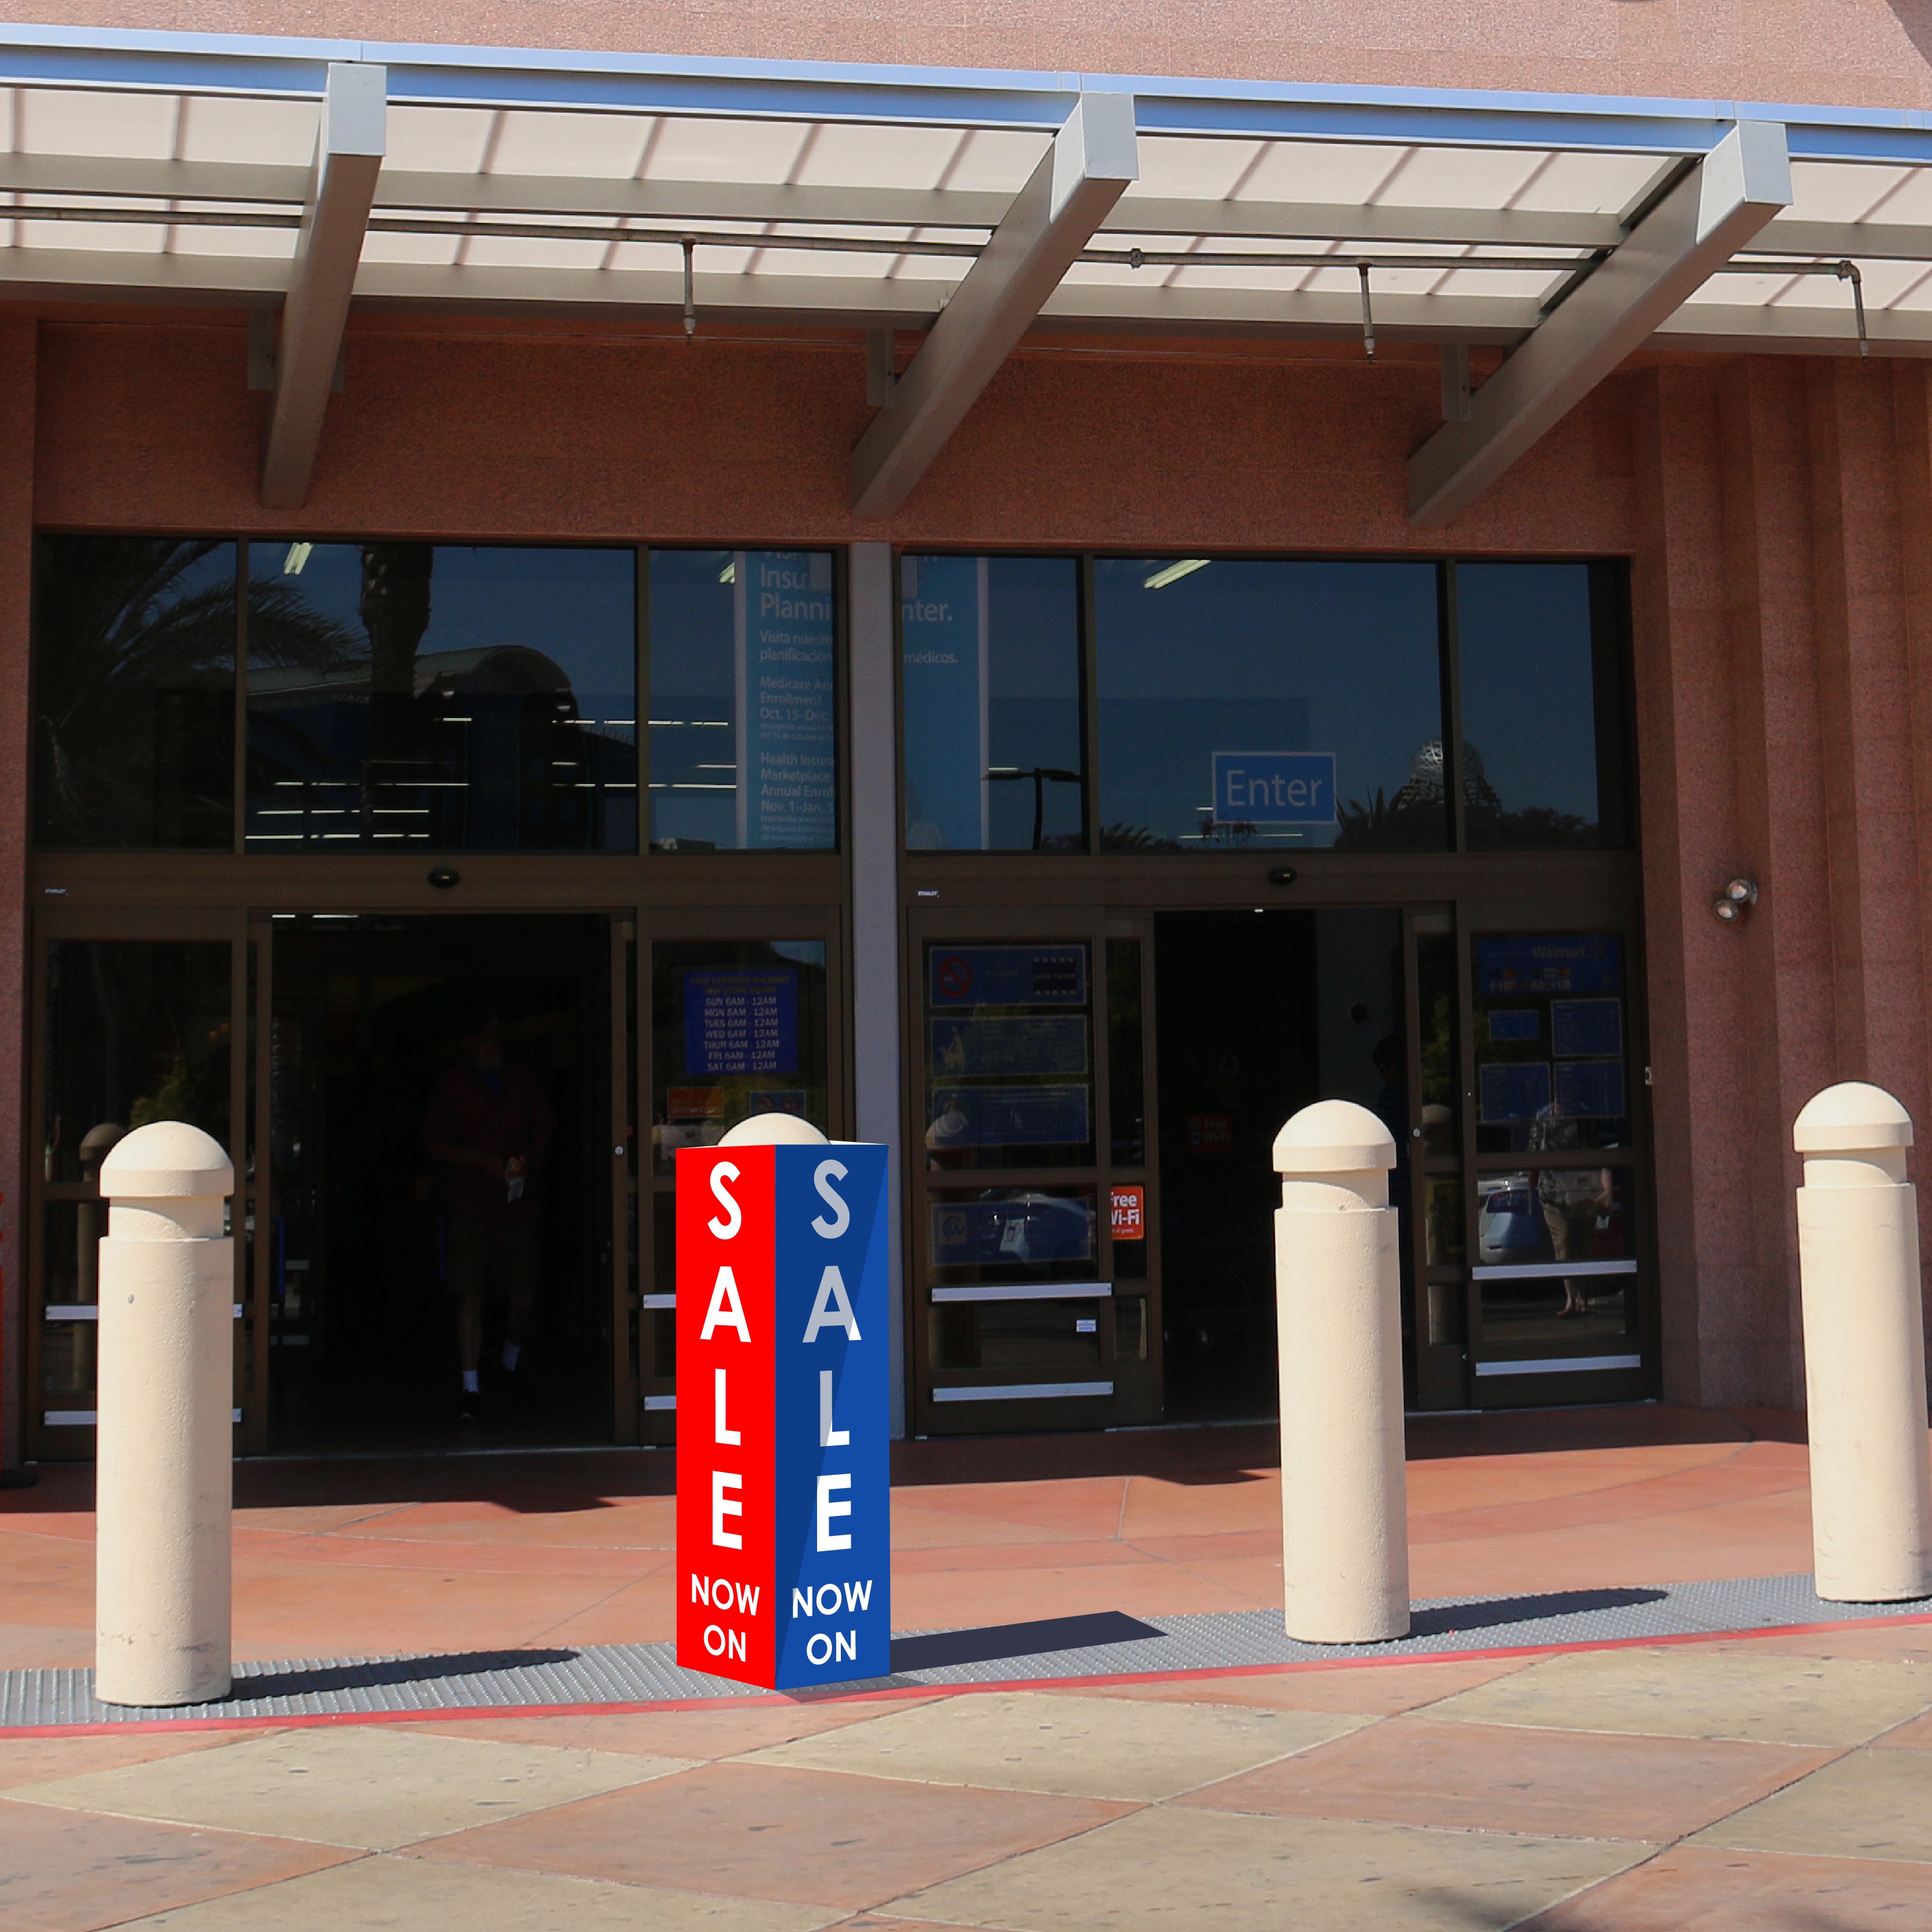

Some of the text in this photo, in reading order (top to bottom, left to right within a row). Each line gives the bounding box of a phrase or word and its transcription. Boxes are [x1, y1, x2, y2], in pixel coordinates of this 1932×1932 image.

[760, 630, 790, 644] Visita
[760, 676, 810, 690] Medicare
[760, 691, 822, 705] Enrollment
[760, 708, 783, 720] Oct.
[760, 752, 798, 765] Health
[760, 768, 831, 782] Marketplace
[760, 783, 801, 797] Annual
[1227, 770, 1322, 806] Enter
[760, 800, 788, 812] Nov.
[1533, 945, 1586, 958] Walmart
[706, 998, 723, 1006] SUN
[726, 997, 745, 1006] 6AM
[752, 997, 777, 1005] 12AM
[705, 1008, 724, 1016] MON
[727, 1008, 746, 1016] 6AM
[754, 1007, 777, 1016] 12AM
[705, 1019, 725, 1027] TUES
[727, 1019, 746, 1027] 6AM
[754, 1018, 778, 1027] 12AM
[727, 1030, 746, 1038] 6AM
[754, 1029, 778, 1038] 12AM
[704, 1041, 727, 1049] THUR
[728, 1040, 748, 1048] 6AM
[755, 1040, 779, 1048] 12AM
[708, 1052, 723, 1060] FRI
[724, 1051, 743, 1060] 6AM
[752, 1051, 775, 1059] 12AM
[708, 1063, 724, 1071] SAT
[726, 1062, 745, 1070] 6AM
[752, 1062, 777, 1070] 12AM
[700, 1161, 752, 1550] SALE
[803, 1160, 862, 1552] SALE
[692, 1574, 760, 1616] NOW
[793, 1580, 872, 1618] NOW
[703, 1625, 746, 1662] ON
[807, 1630, 856, 1665] ON
